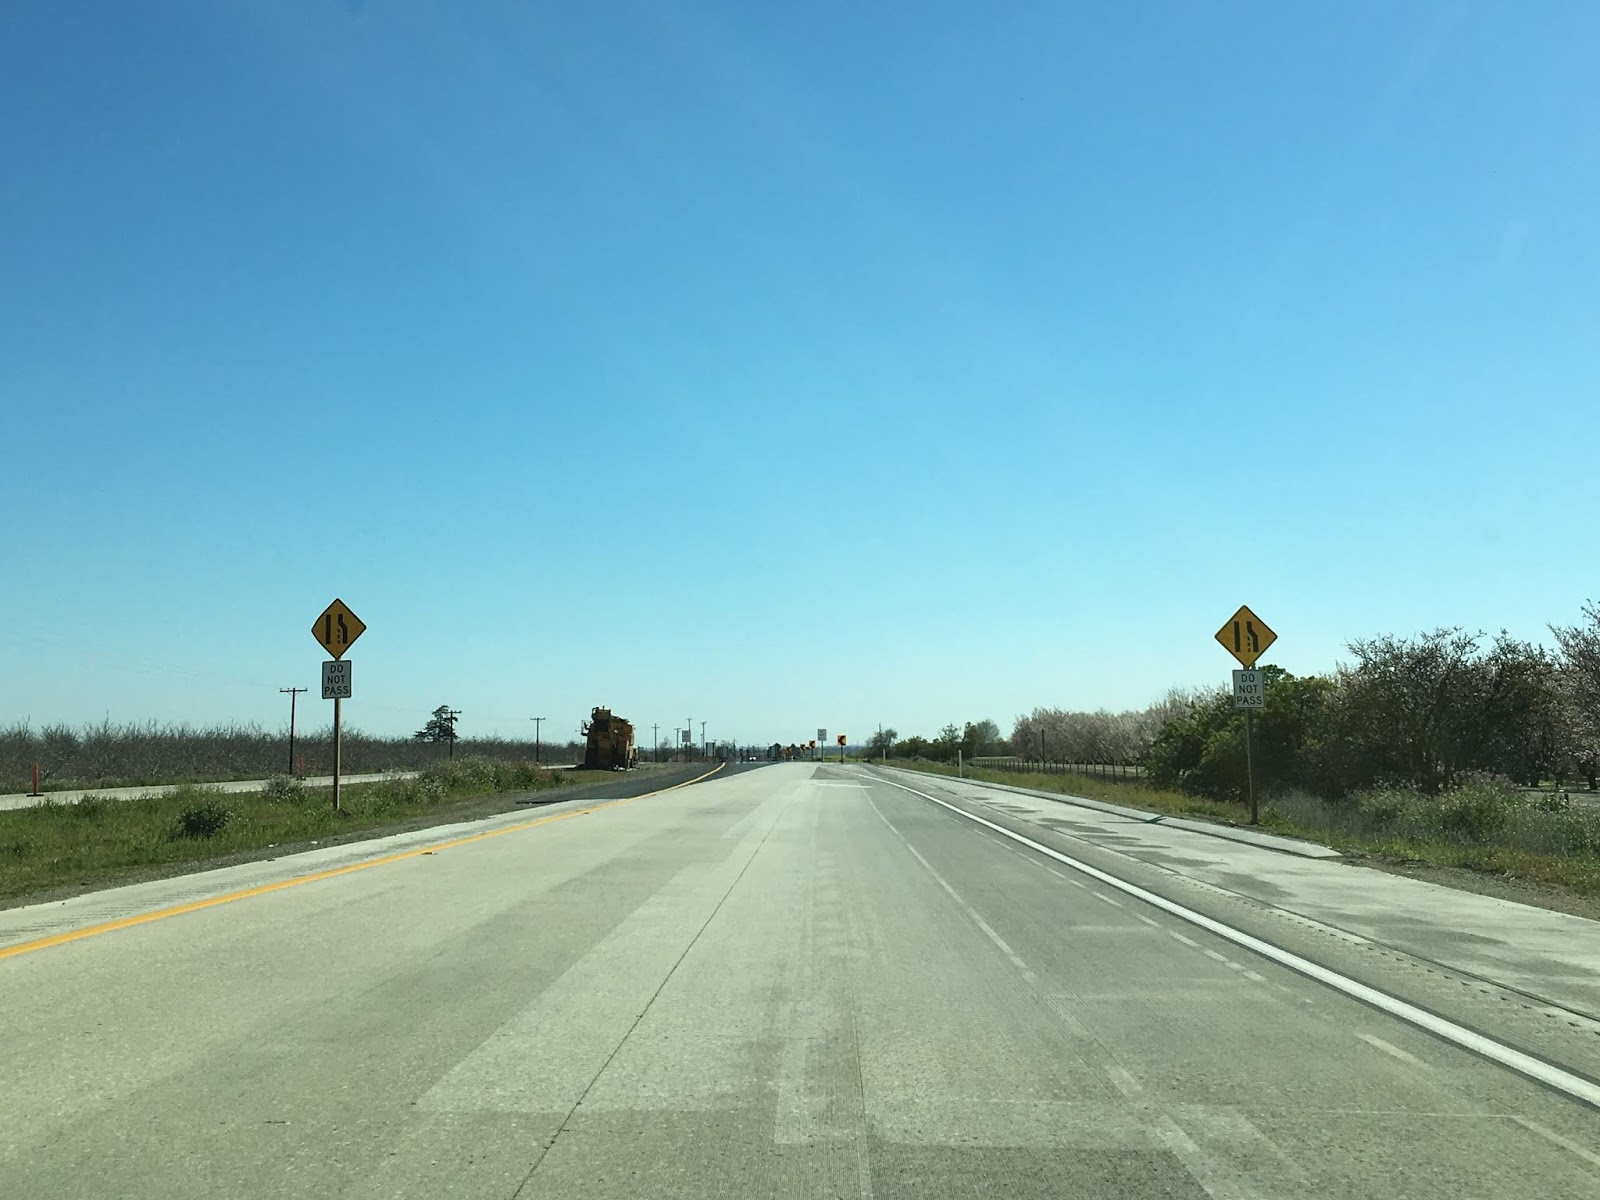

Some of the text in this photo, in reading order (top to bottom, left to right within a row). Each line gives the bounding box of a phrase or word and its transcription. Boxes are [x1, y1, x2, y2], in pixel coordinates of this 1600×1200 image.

[330, 664, 344, 673] DO
[327, 675, 346, 684] NOT
[1241, 673, 1255, 683] DO
[324, 685, 349, 695] PASS
[1238, 684, 1258, 694] NOT
[1236, 695, 1263, 705] PASS
